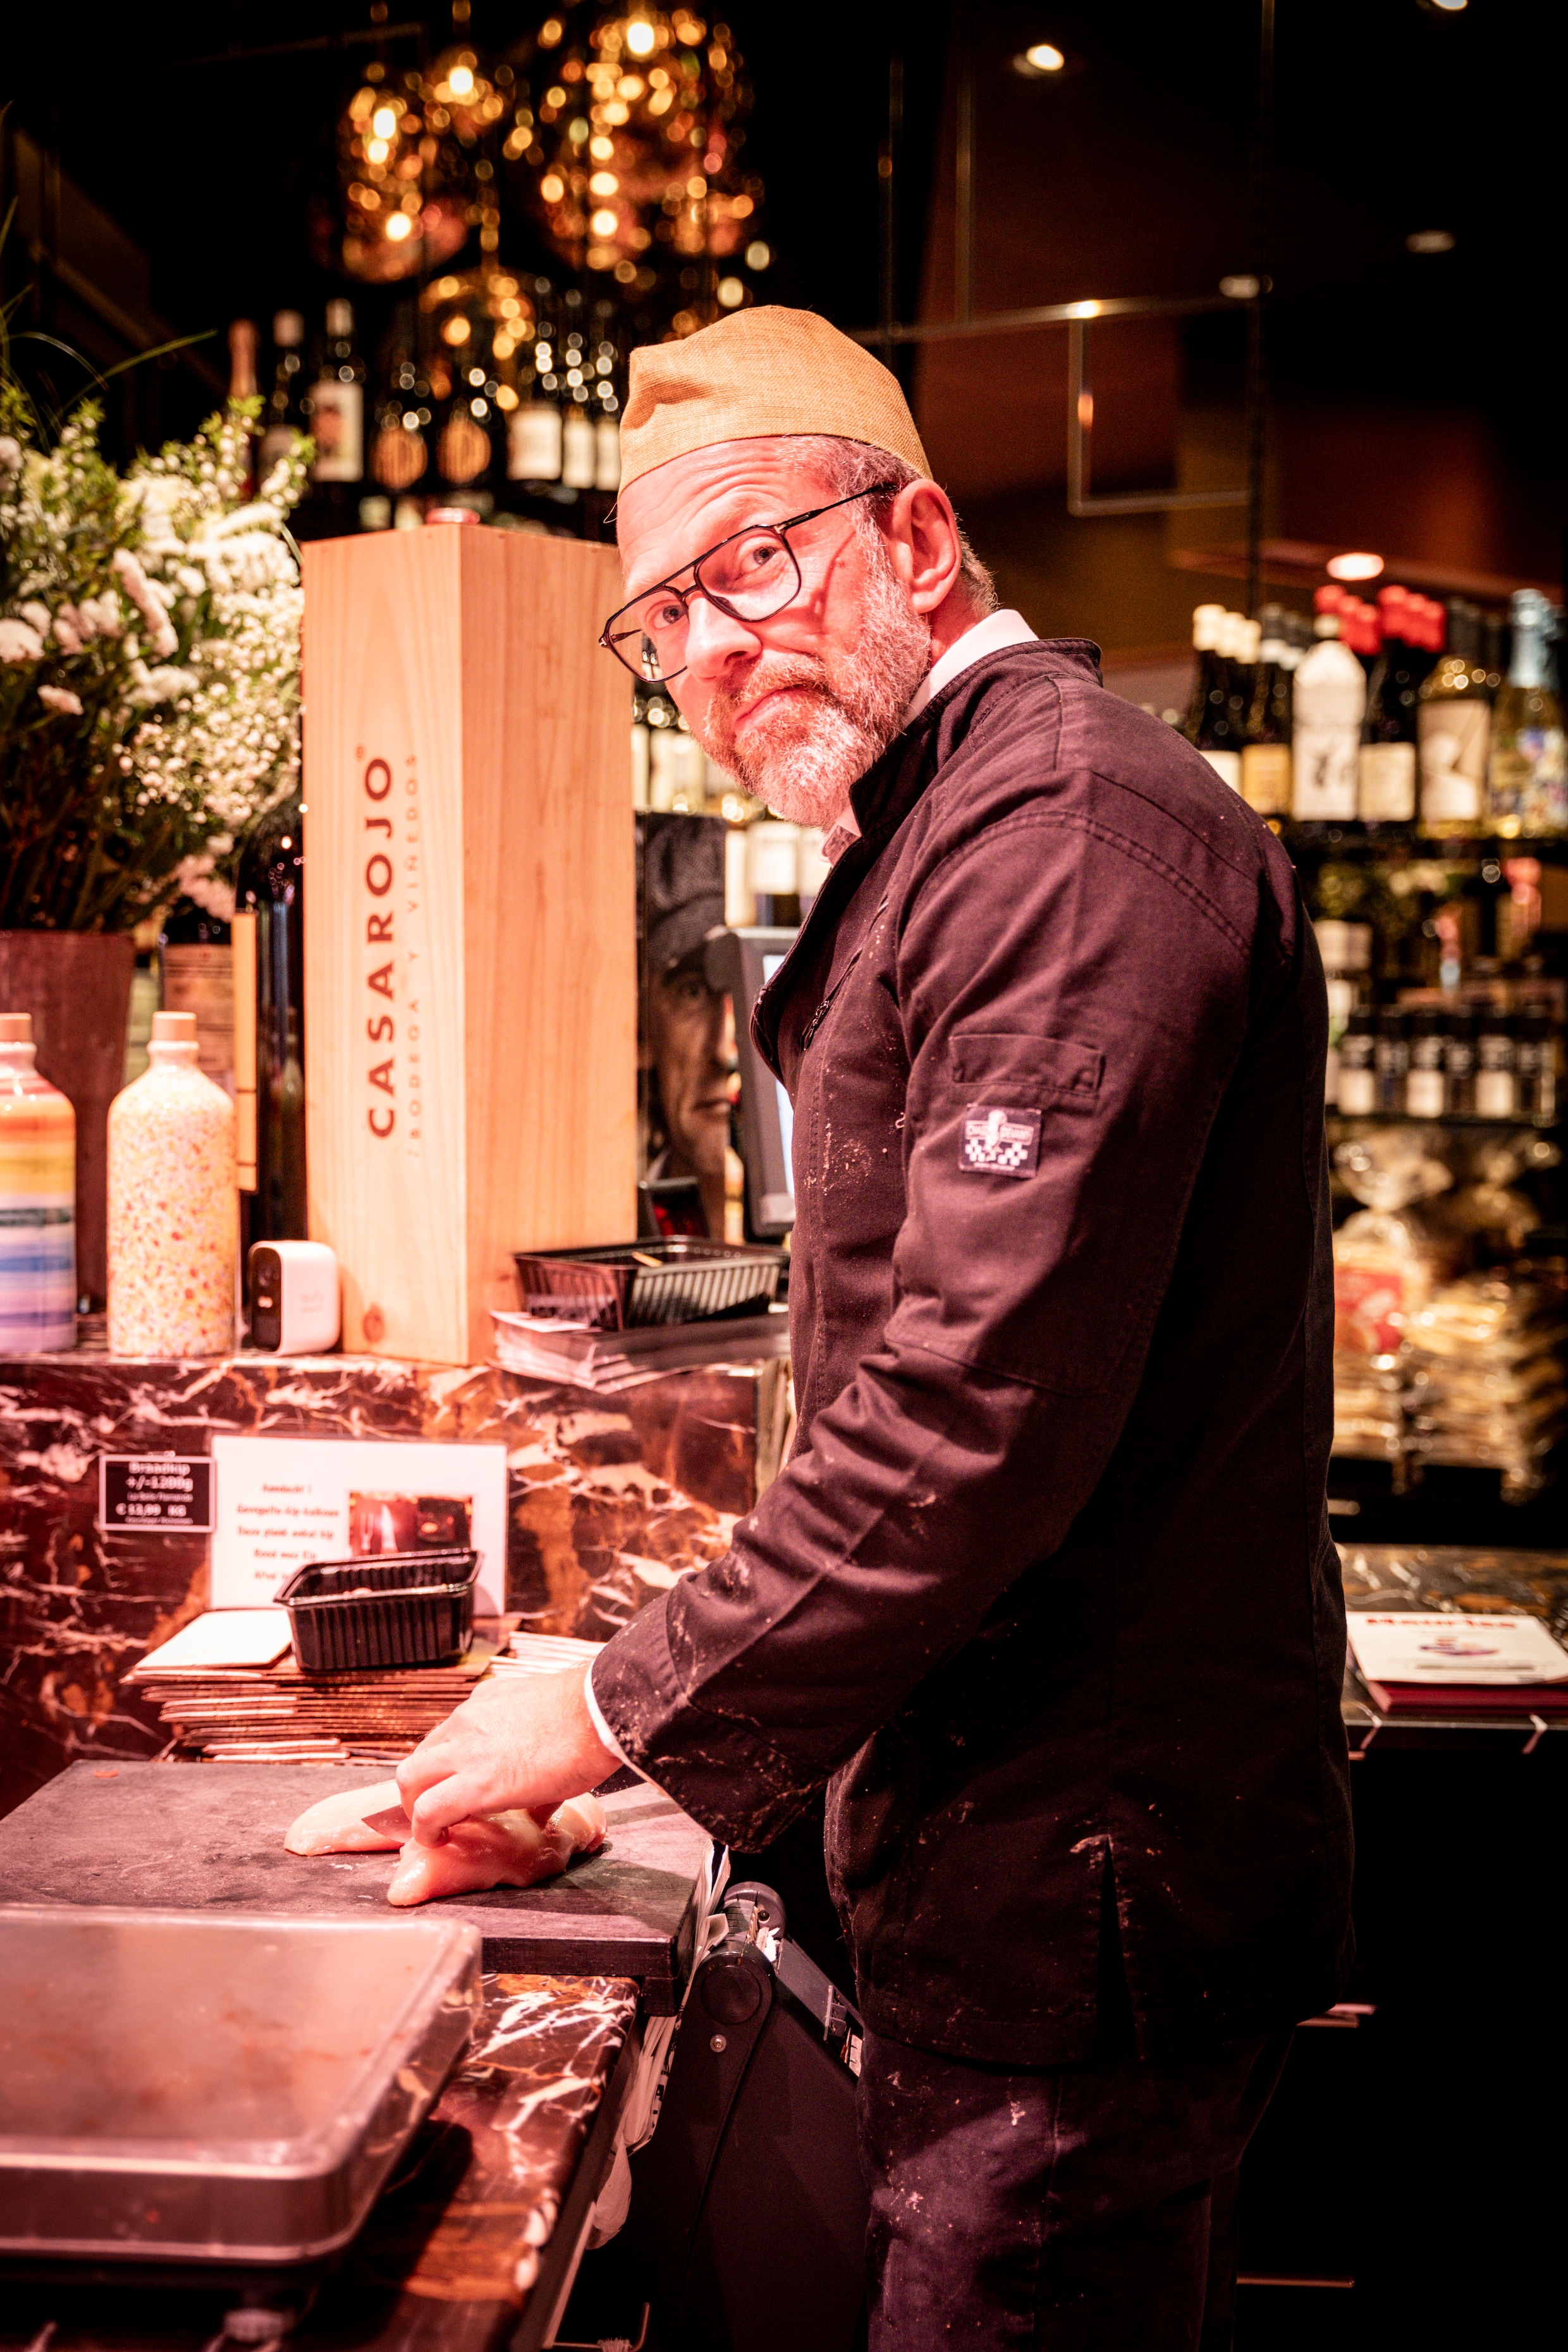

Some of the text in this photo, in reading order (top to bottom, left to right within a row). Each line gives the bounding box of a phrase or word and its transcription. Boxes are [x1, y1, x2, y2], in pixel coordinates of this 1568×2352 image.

[365, 758, 394, 1137] CASAROJO
[403, 754, 422, 1139] BODEGA Y VIÑEDOS
[129, 1462, 190, 1476] Braadkip
[261, 1483, 304, 1493] Aandacht
[168, 1505, 185, 1516] KG
[237, 1525, 334, 1541] Deze plank enkel kip
